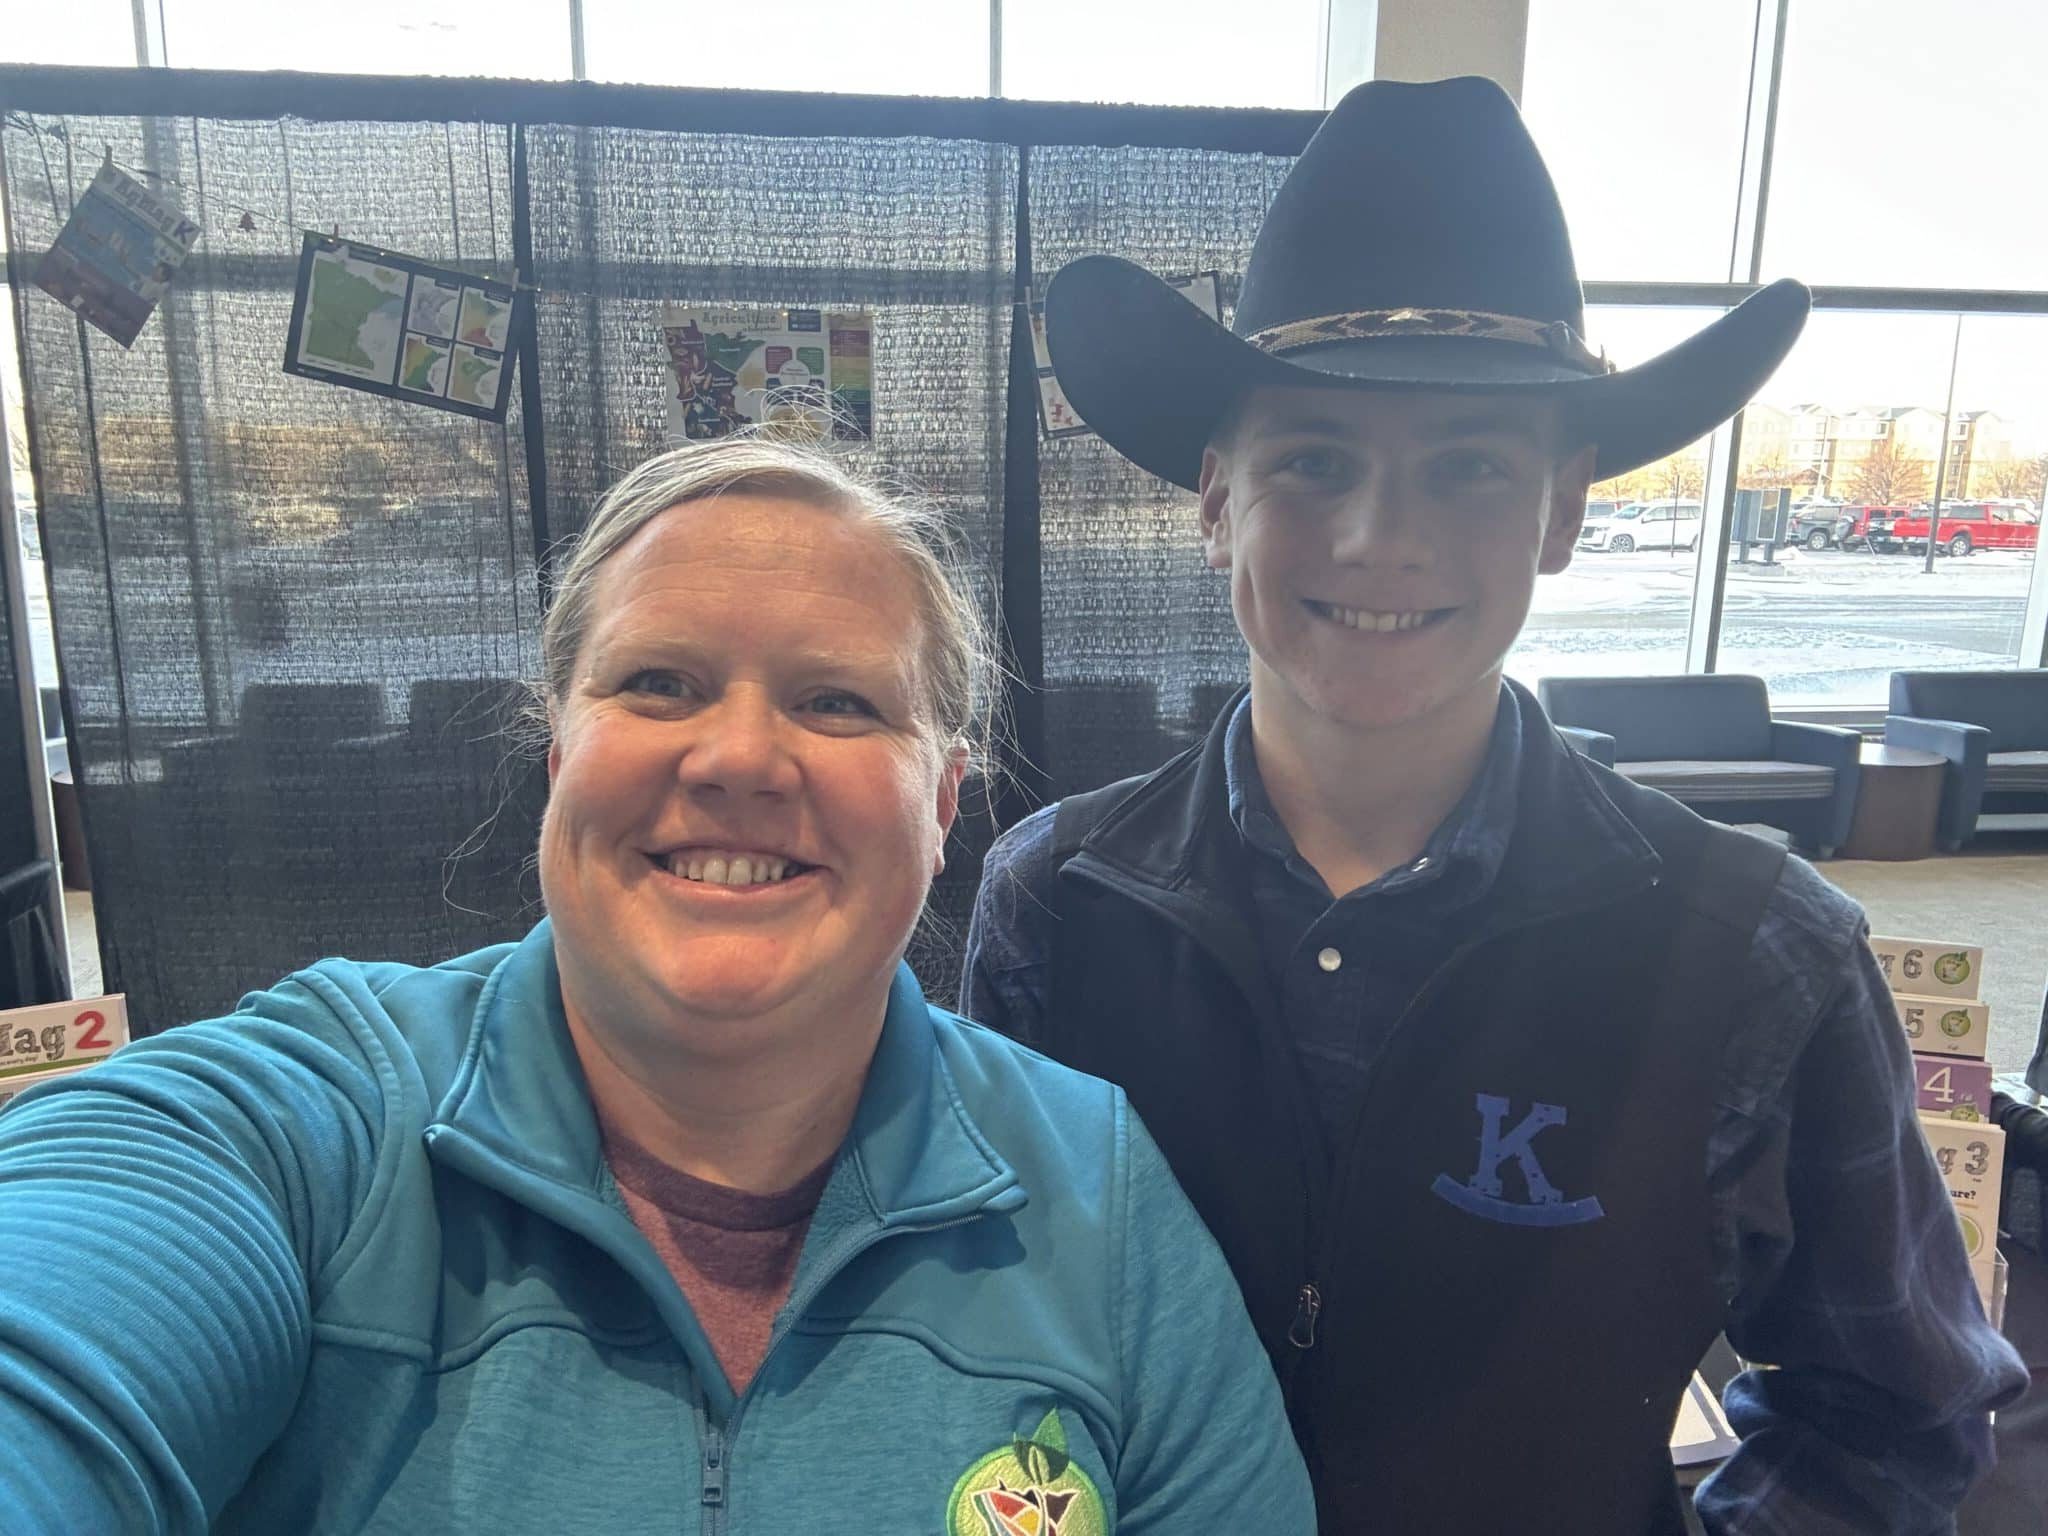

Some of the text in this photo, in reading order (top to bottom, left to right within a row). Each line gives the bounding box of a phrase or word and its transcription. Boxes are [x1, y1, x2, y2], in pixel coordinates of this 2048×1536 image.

[173, 219, 195, 244] K
[702, 311, 777, 328] Agriculture
[1902, 948, 1924, 980] 6
[73, 1010, 113, 1050] 2
[1905, 1008, 1925, 1039] 5
[1922, 1066, 1954, 1102] 4
[1469, 1092, 1568, 1205] K
[1965, 1141, 1990, 1176] 3
